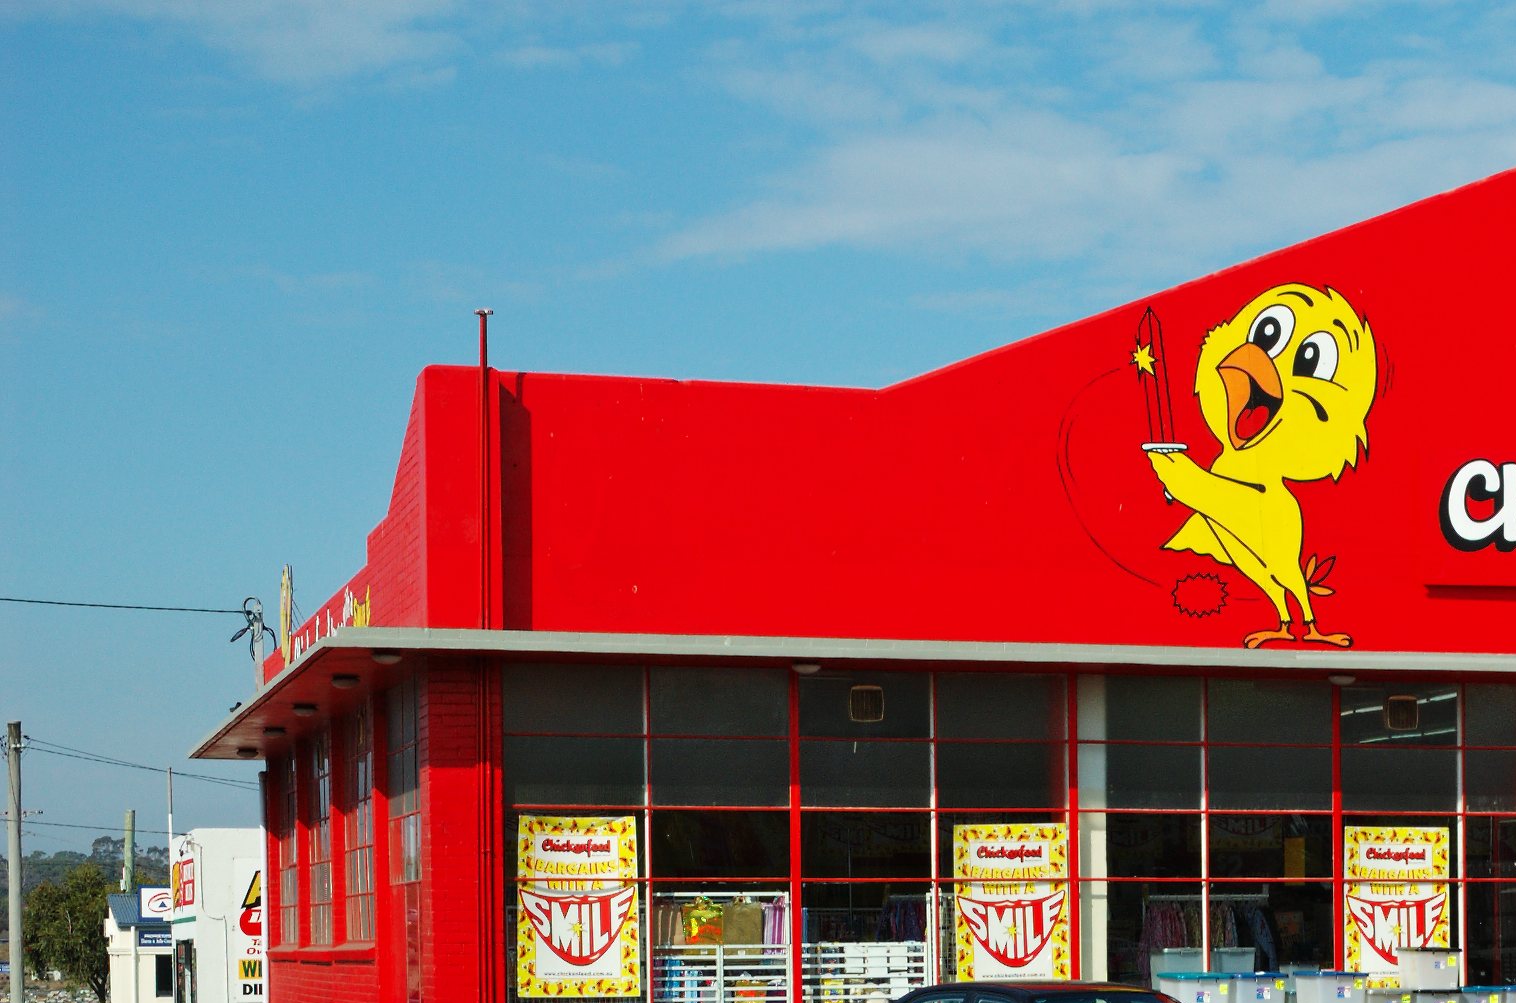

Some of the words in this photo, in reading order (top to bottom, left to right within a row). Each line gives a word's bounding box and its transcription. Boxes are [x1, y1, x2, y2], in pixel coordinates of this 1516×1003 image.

[542, 838, 610, 858] Chickenfeed
[977, 845, 1042, 862] Chickenfeed
[1366, 847, 1425, 864] Chickenfeed
[535, 859, 618, 875] BARGAINS
[971, 865, 1049, 878] BARGAINS
[1359, 867, 1431, 879] BARGAINS
[547, 880, 585, 891] WITH
[591, 880, 604, 890] A
[983, 882, 1020, 895] WITH
[1024, 882, 1036, 894] A
[1369, 883, 1404, 895] WITH
[1408, 883, 1420, 895] A
[520, 887, 635, 957] SMILE
[957, 890, 1065, 959] SMILE
[1346, 892, 1447, 956] SMILE
